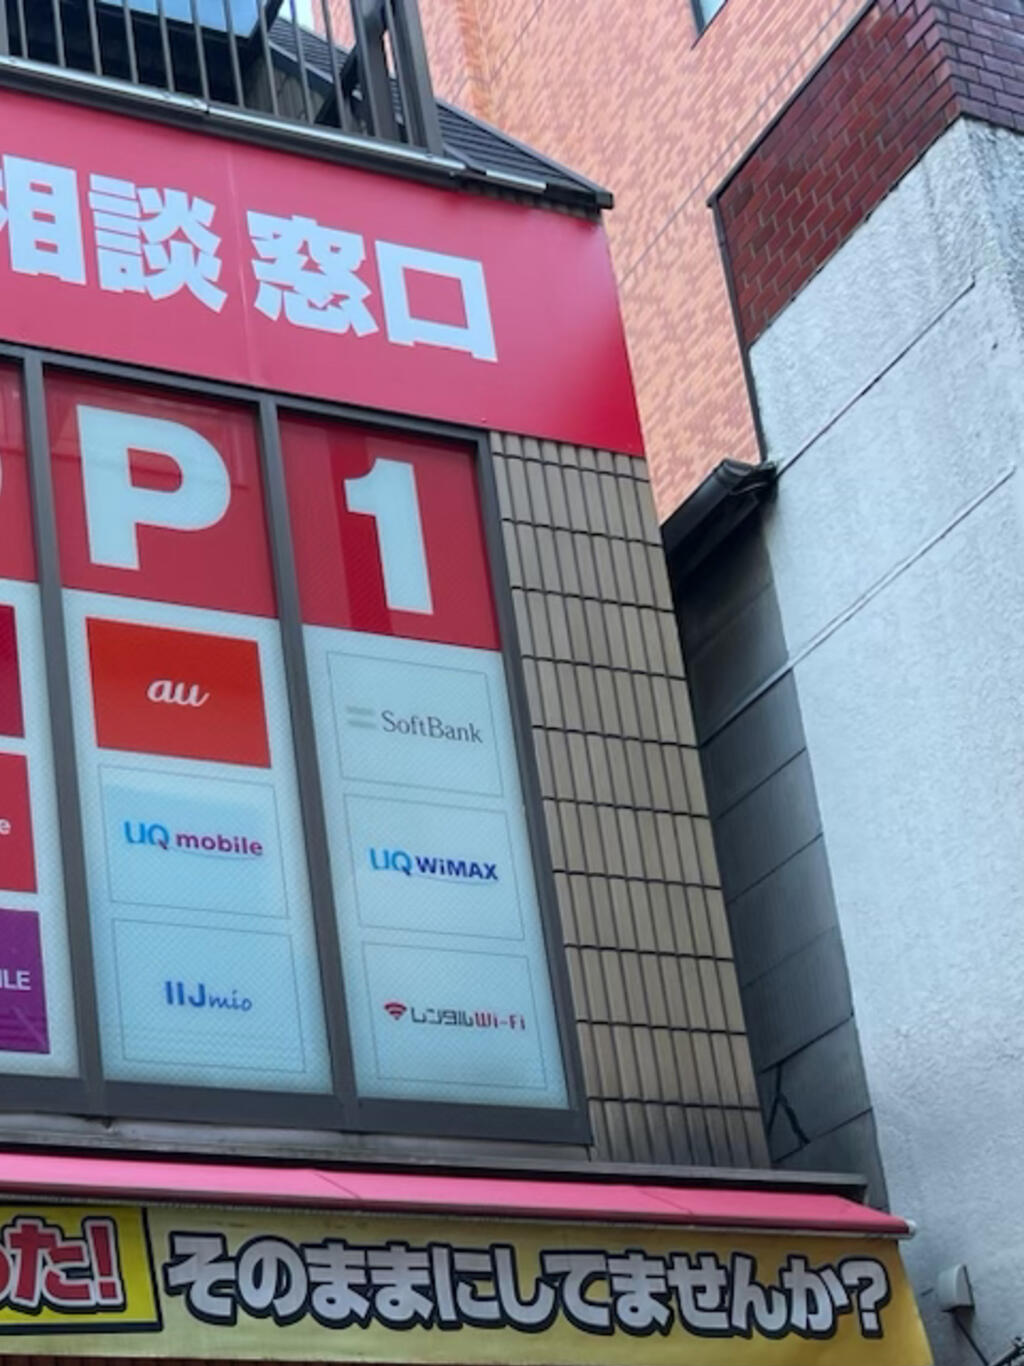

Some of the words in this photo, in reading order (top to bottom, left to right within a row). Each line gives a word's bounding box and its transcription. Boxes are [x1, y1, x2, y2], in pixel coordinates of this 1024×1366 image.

[146, 677, 209, 708] au
[380, 709, 483, 745] SoftBank
[124, 821, 170, 850] UQ
[176, 829, 263, 856] mobile
[370, 847, 412, 875] UQ
[415, 855, 498, 882] WiMAX
[166, 1232, 892, 1339] そのままにしてませんか?
